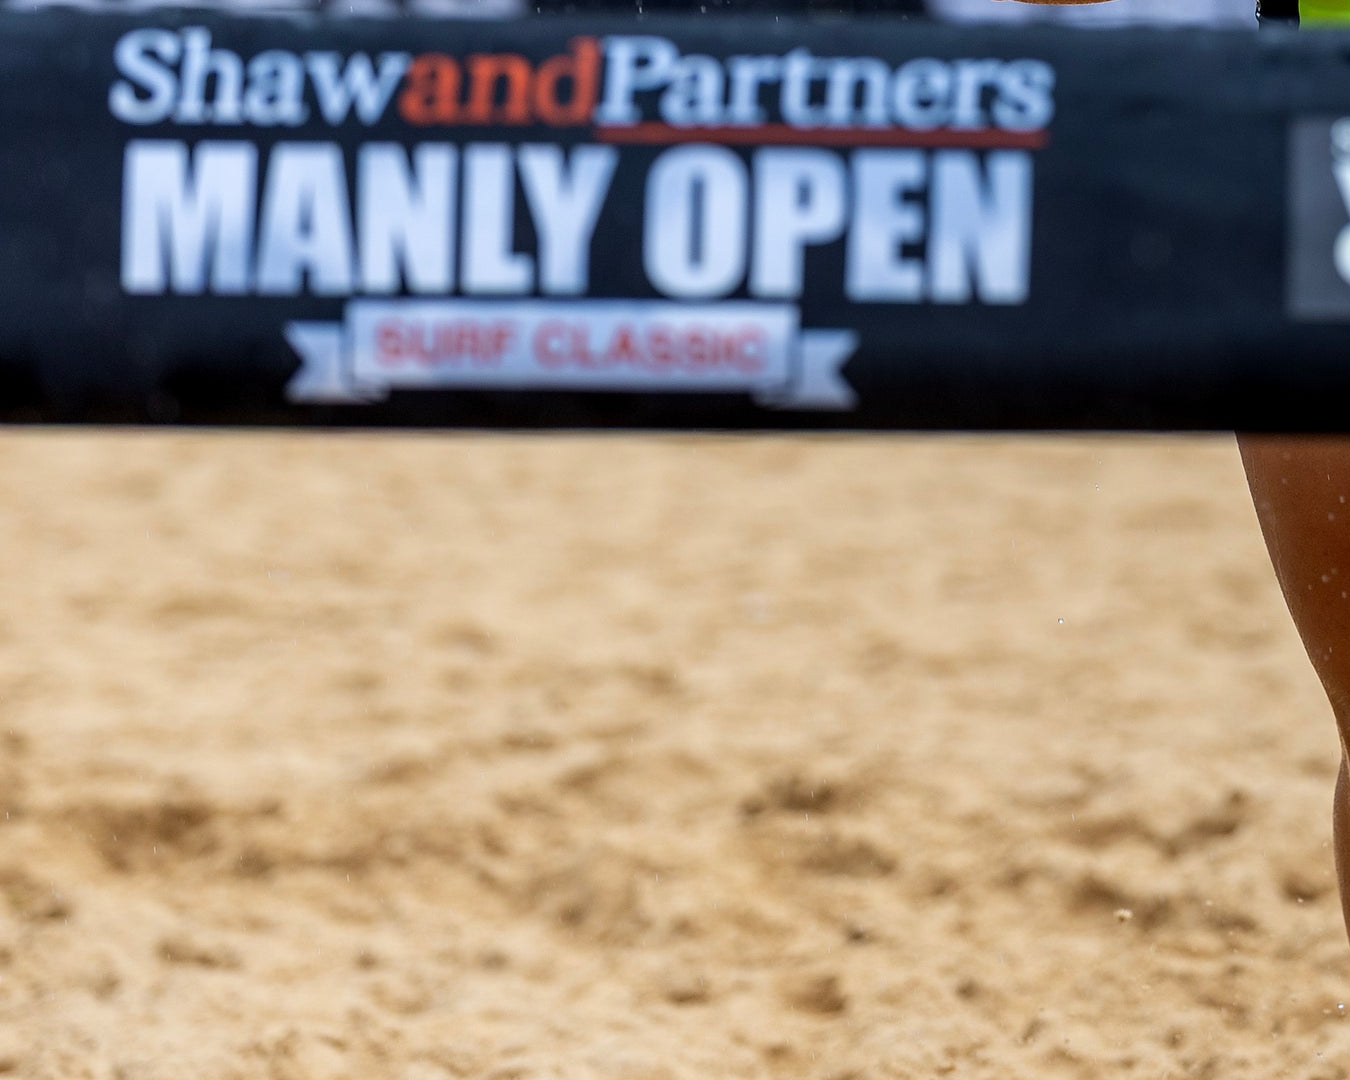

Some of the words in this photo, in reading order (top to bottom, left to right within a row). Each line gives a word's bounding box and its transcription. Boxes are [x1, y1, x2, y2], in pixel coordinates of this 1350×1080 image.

[110, 27, 1054, 128] ShawandPartners
[121, 138, 619, 298] MANLY
[642, 143, 1034, 305] OPEN
[373, 319, 512, 366] SURF
[532, 322, 767, 373] CLASSIC
